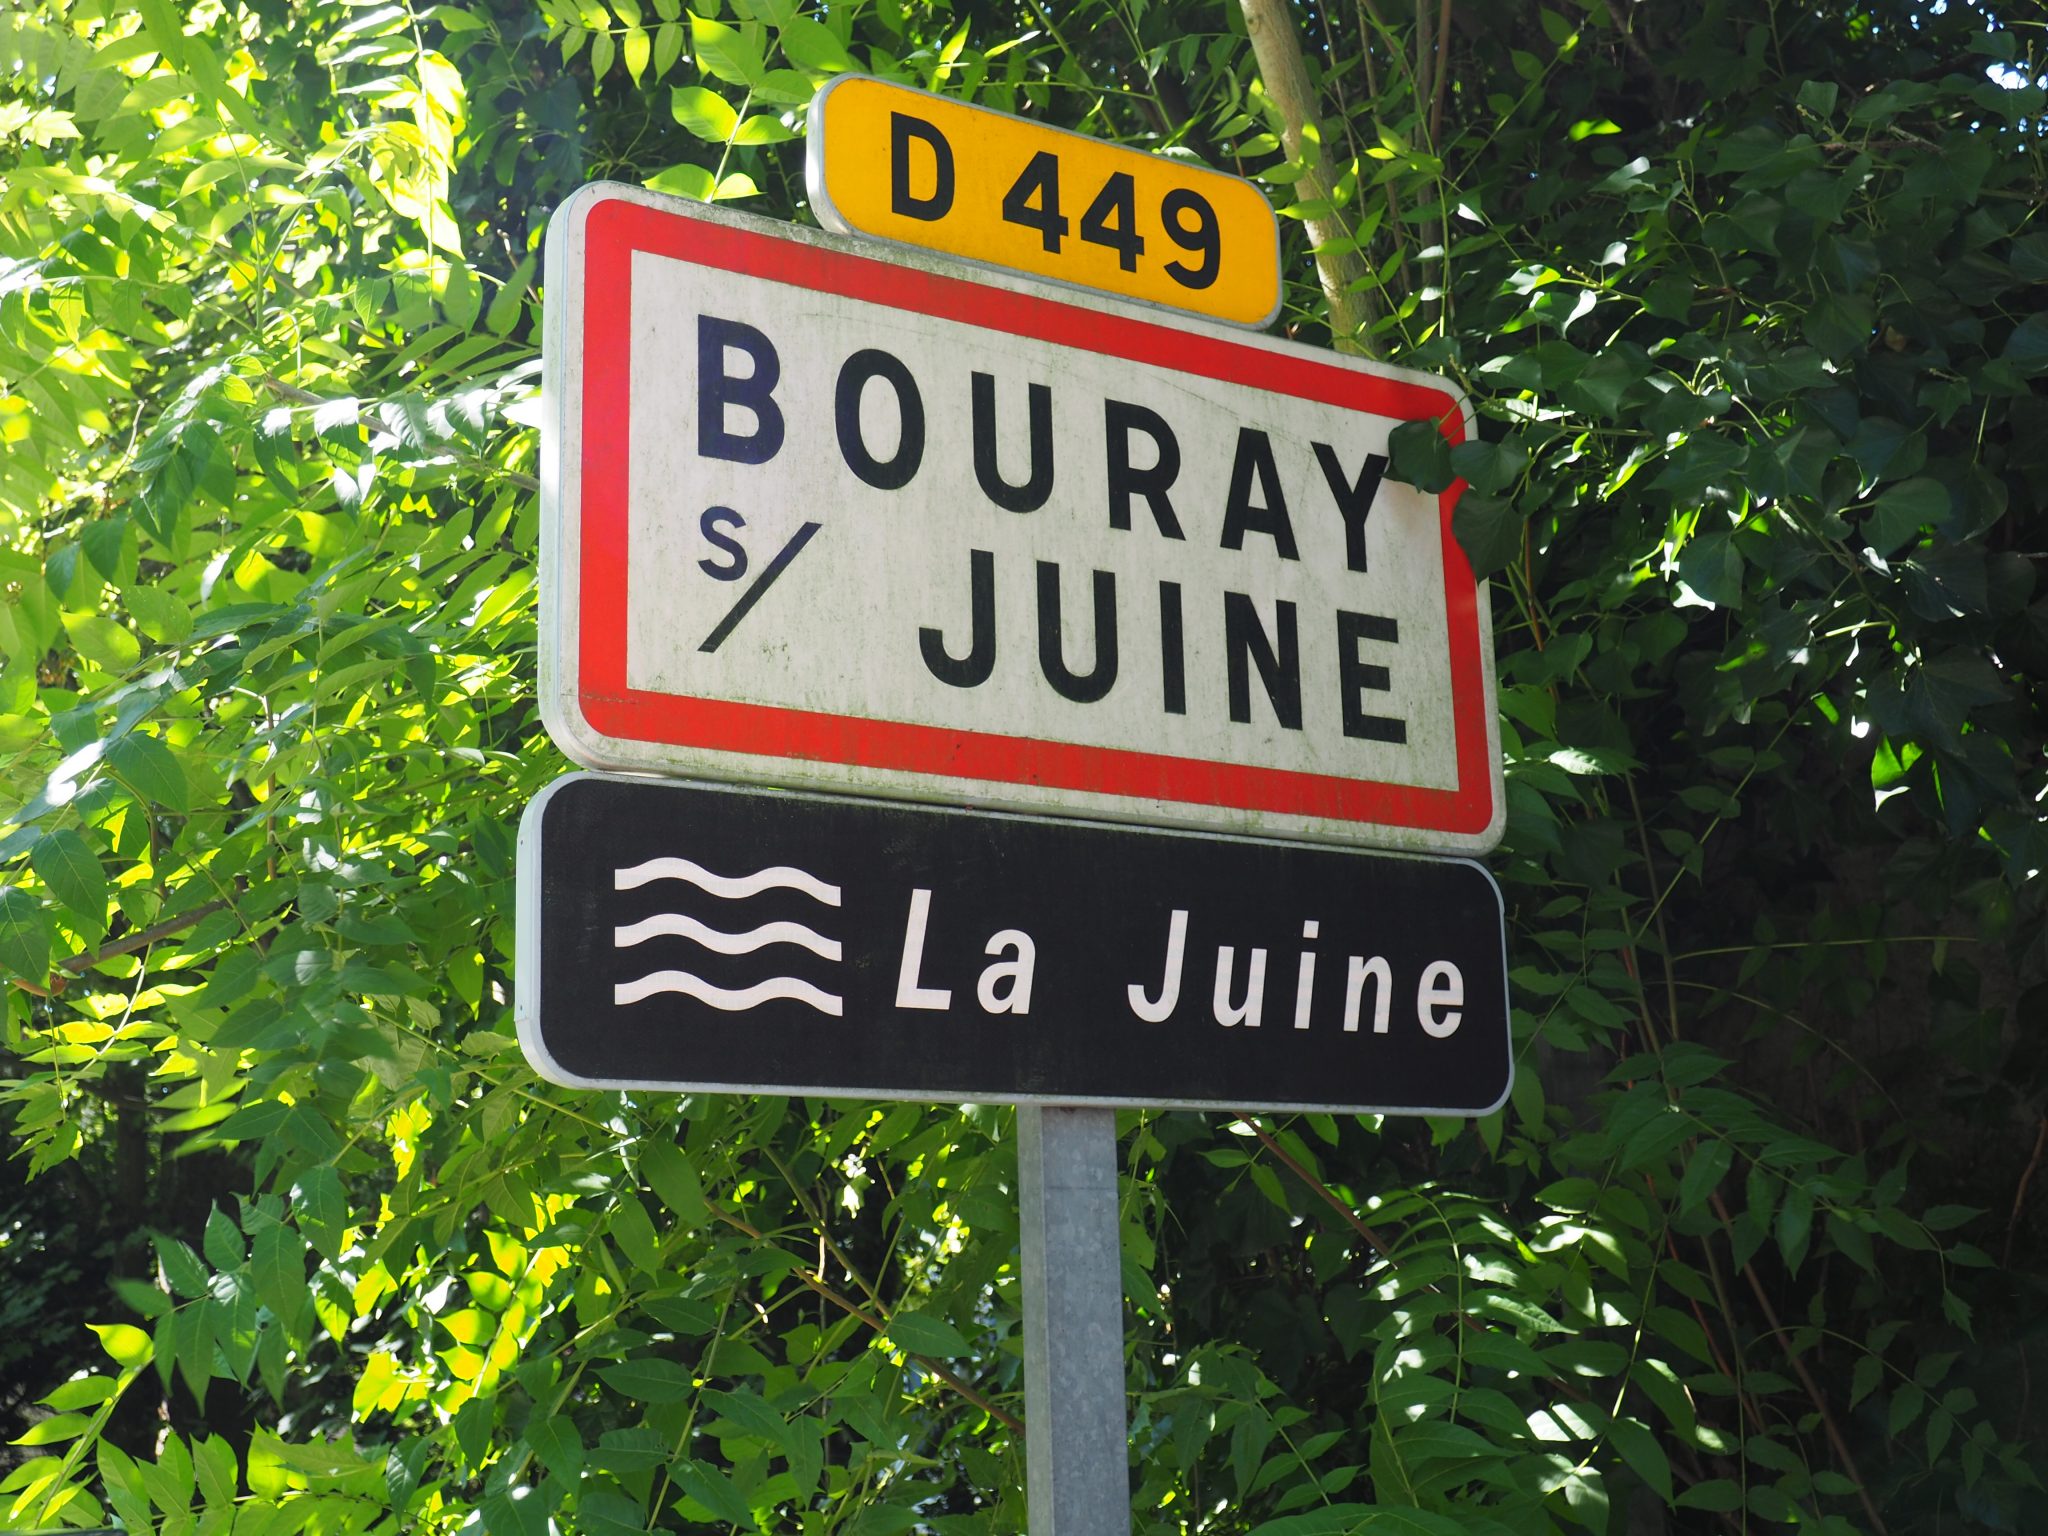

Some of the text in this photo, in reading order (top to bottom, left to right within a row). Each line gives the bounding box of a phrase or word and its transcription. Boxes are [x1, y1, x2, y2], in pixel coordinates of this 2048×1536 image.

[890, 111, 1222, 290] D 449
[697, 314, 1390, 573] BOURAY
[919, 549, 1407, 745] JUINE
[895, 889, 1465, 1038] La Juine
